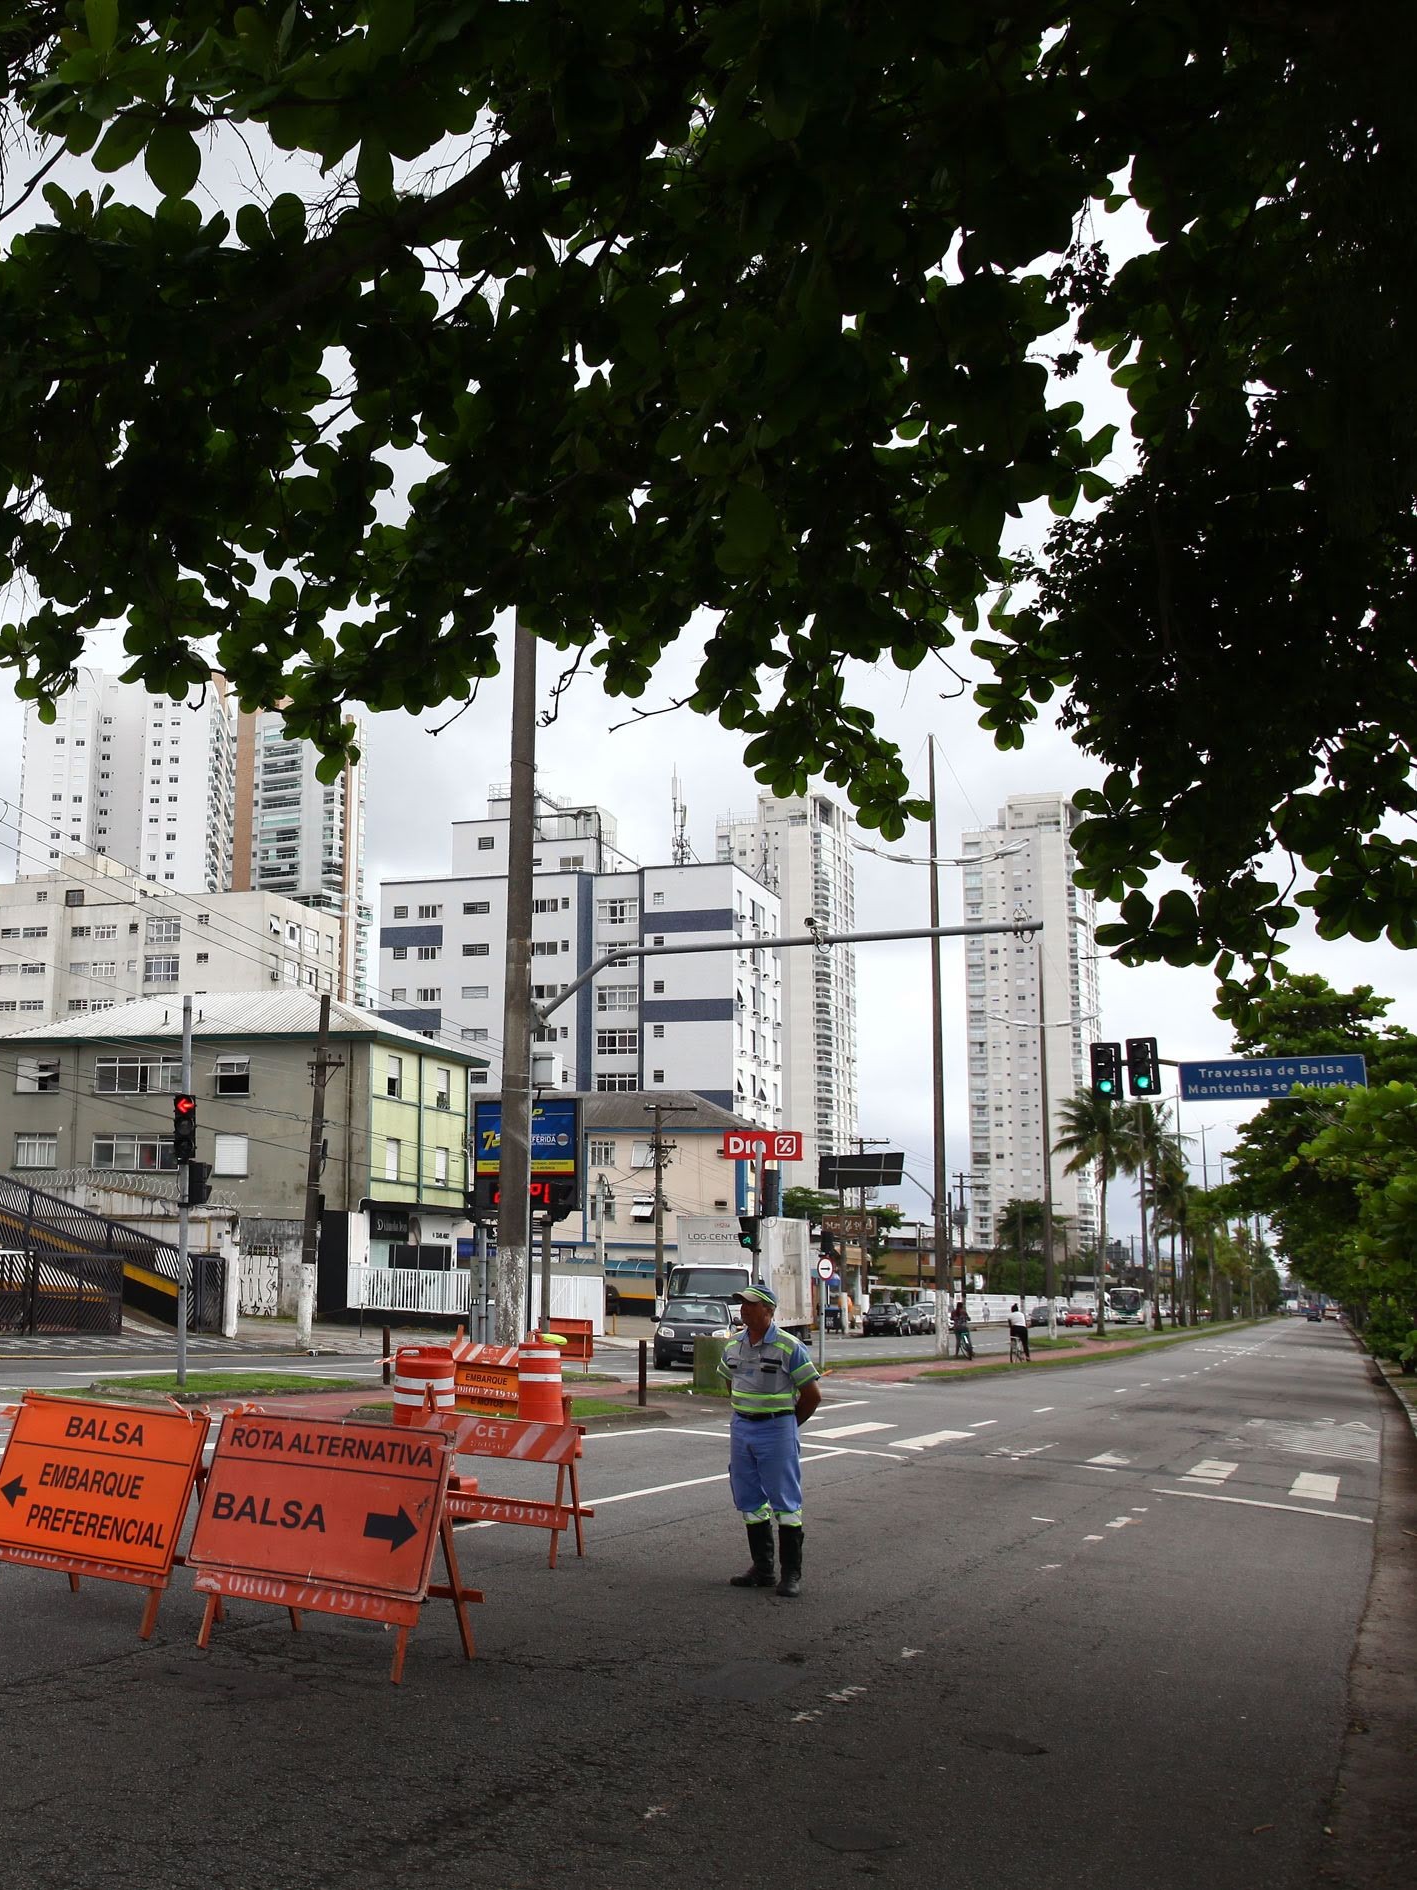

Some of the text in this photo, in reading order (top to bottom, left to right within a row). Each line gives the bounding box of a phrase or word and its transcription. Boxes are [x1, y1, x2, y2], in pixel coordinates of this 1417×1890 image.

[1198, 1064, 1344, 1079] Travessia de Balsa
[482, 1347, 501, 1355] CET
[465, 1373, 508, 1385] EMBARQUE
[65, 1416, 145, 1447] BALSA
[475, 1424, 510, 1439] CET
[230, 1427, 433, 1468] ROTA ALTERNATIVA
[38, 1462, 145, 1500] EMBARQUE
[211, 1491, 326, 1533] BALSA
[25, 1503, 166, 1550] PREFERENCIAL
[228, 1574, 287, 1599] 0800
